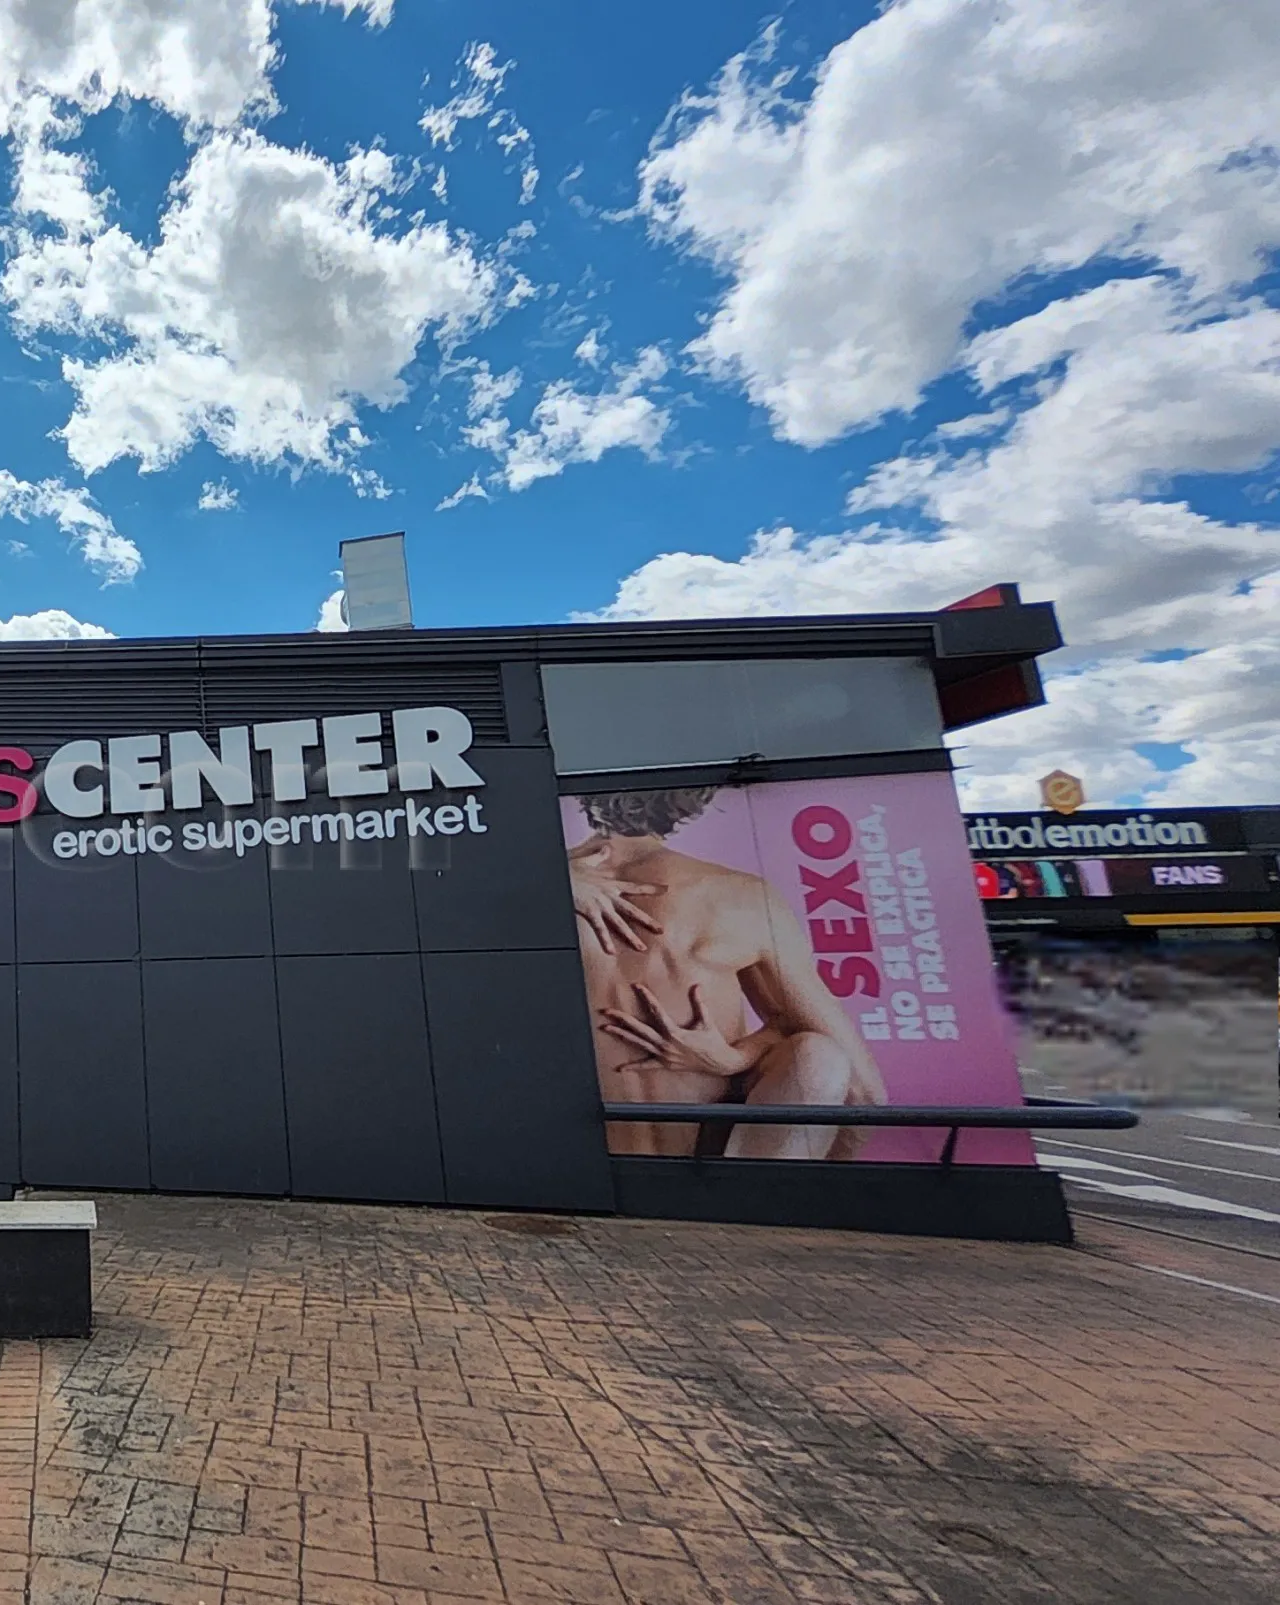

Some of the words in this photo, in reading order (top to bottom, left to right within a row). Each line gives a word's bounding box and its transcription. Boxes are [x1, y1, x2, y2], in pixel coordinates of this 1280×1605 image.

[44, 706, 486, 818] CENTER
[52, 819, 173, 859] erotic
[182, 794, 489, 858] supermarket
[967, 814, 1208, 850] tbolemotion
[1152, 865, 1224, 885] FANS
[792, 805, 882, 999] SEXO
[880, 946, 915, 981] SE
[859, 1006, 893, 1041] EL
[891, 990, 927, 1041] NO
[925, 1004, 960, 1041] SE
